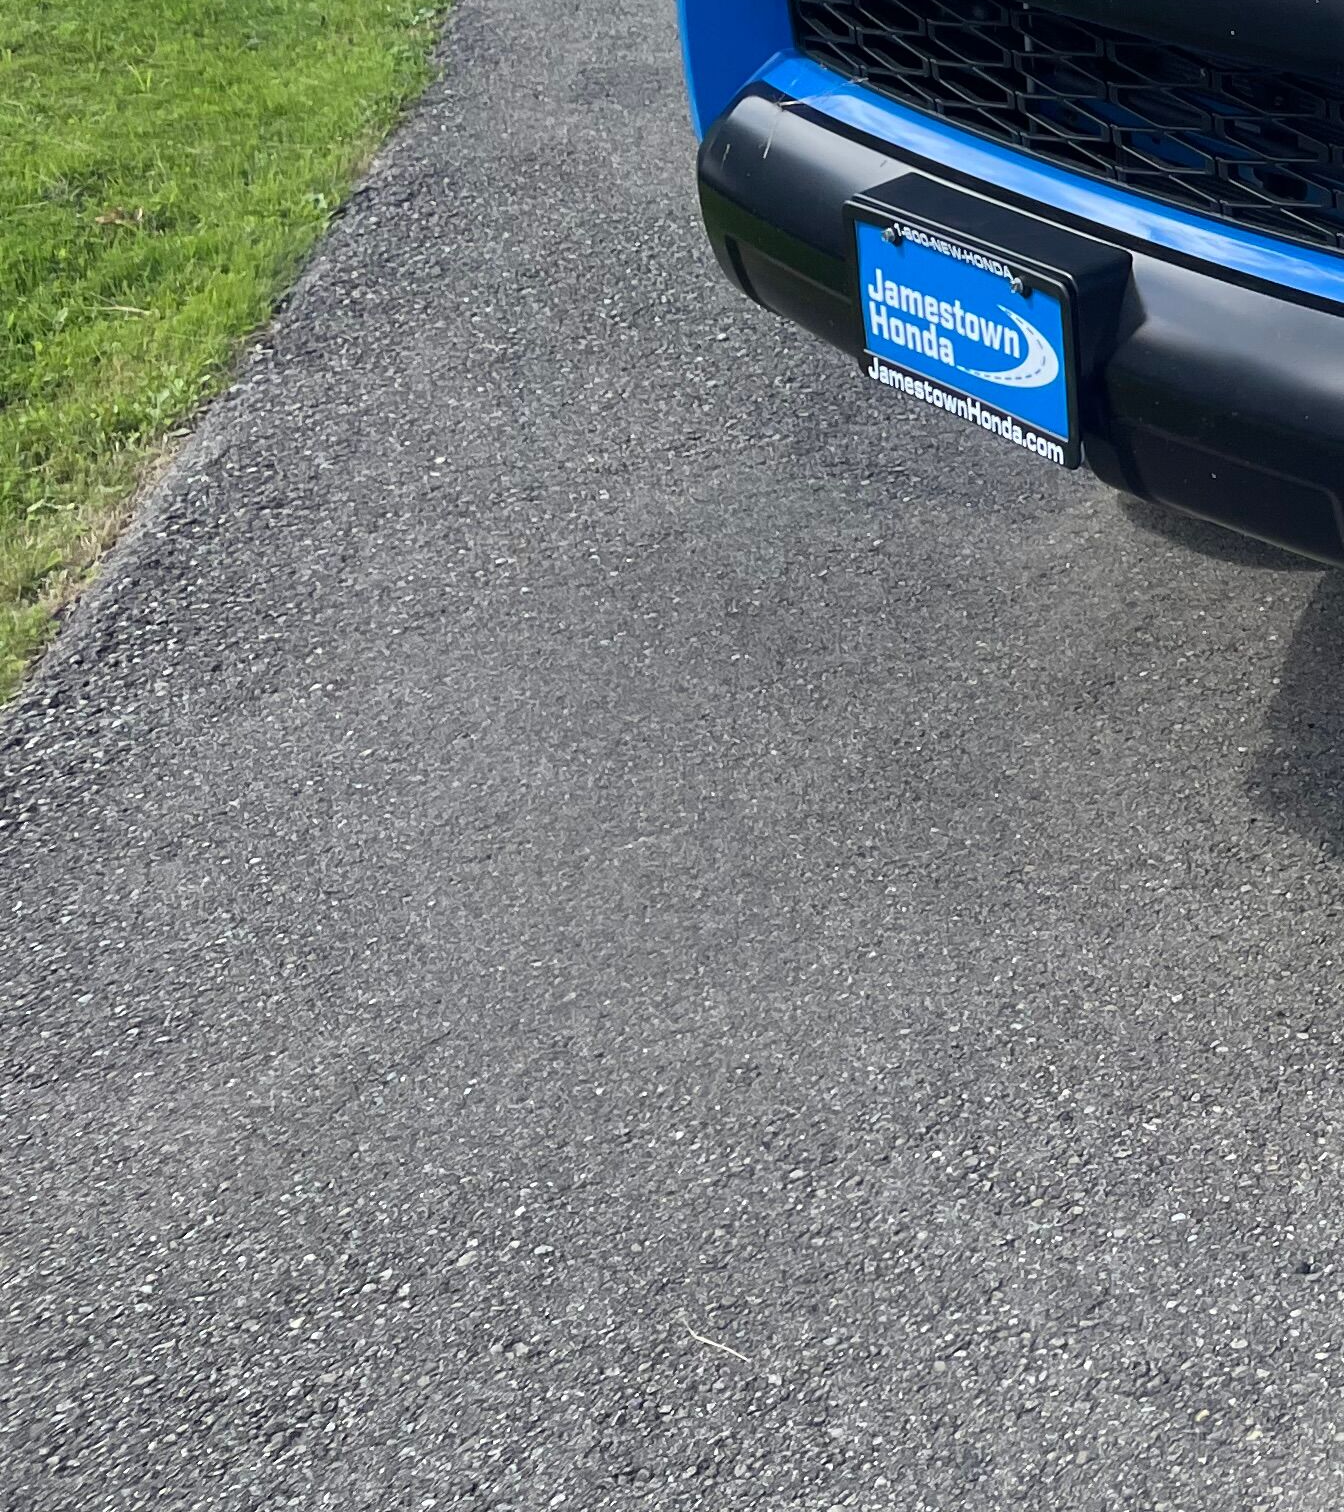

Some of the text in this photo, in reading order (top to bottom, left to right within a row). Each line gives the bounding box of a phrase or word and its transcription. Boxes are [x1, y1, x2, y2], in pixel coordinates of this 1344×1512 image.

[868, 268, 1021, 359] Jamestown
[868, 301, 956, 367] Honda
[868, 357, 1065, 465] JamestownHonda.com
